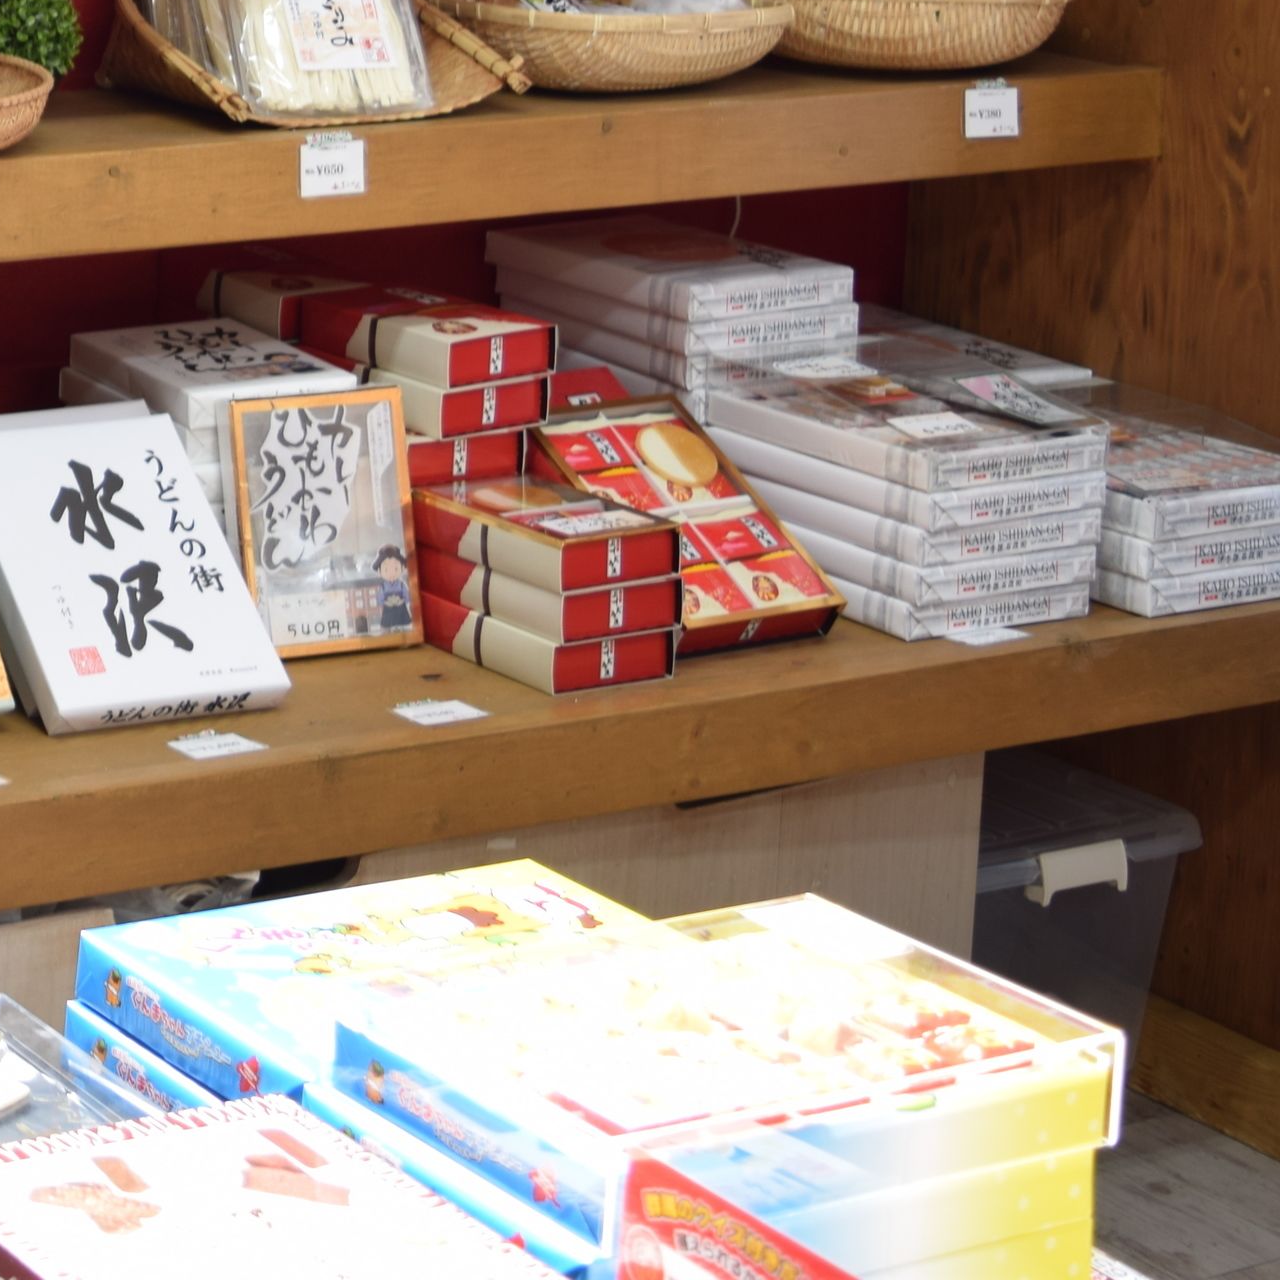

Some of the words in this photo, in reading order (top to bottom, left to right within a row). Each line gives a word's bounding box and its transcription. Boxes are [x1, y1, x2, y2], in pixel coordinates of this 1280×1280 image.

[316, 164, 344, 176] ¥650
[143, 448, 226, 594] うどんの街
[49, 459, 195, 659] 水沢
[287, 619, 341, 638] 540円
[100, 699, 196, 723] うどんの街
[202, 692, 252, 713] 水沢
